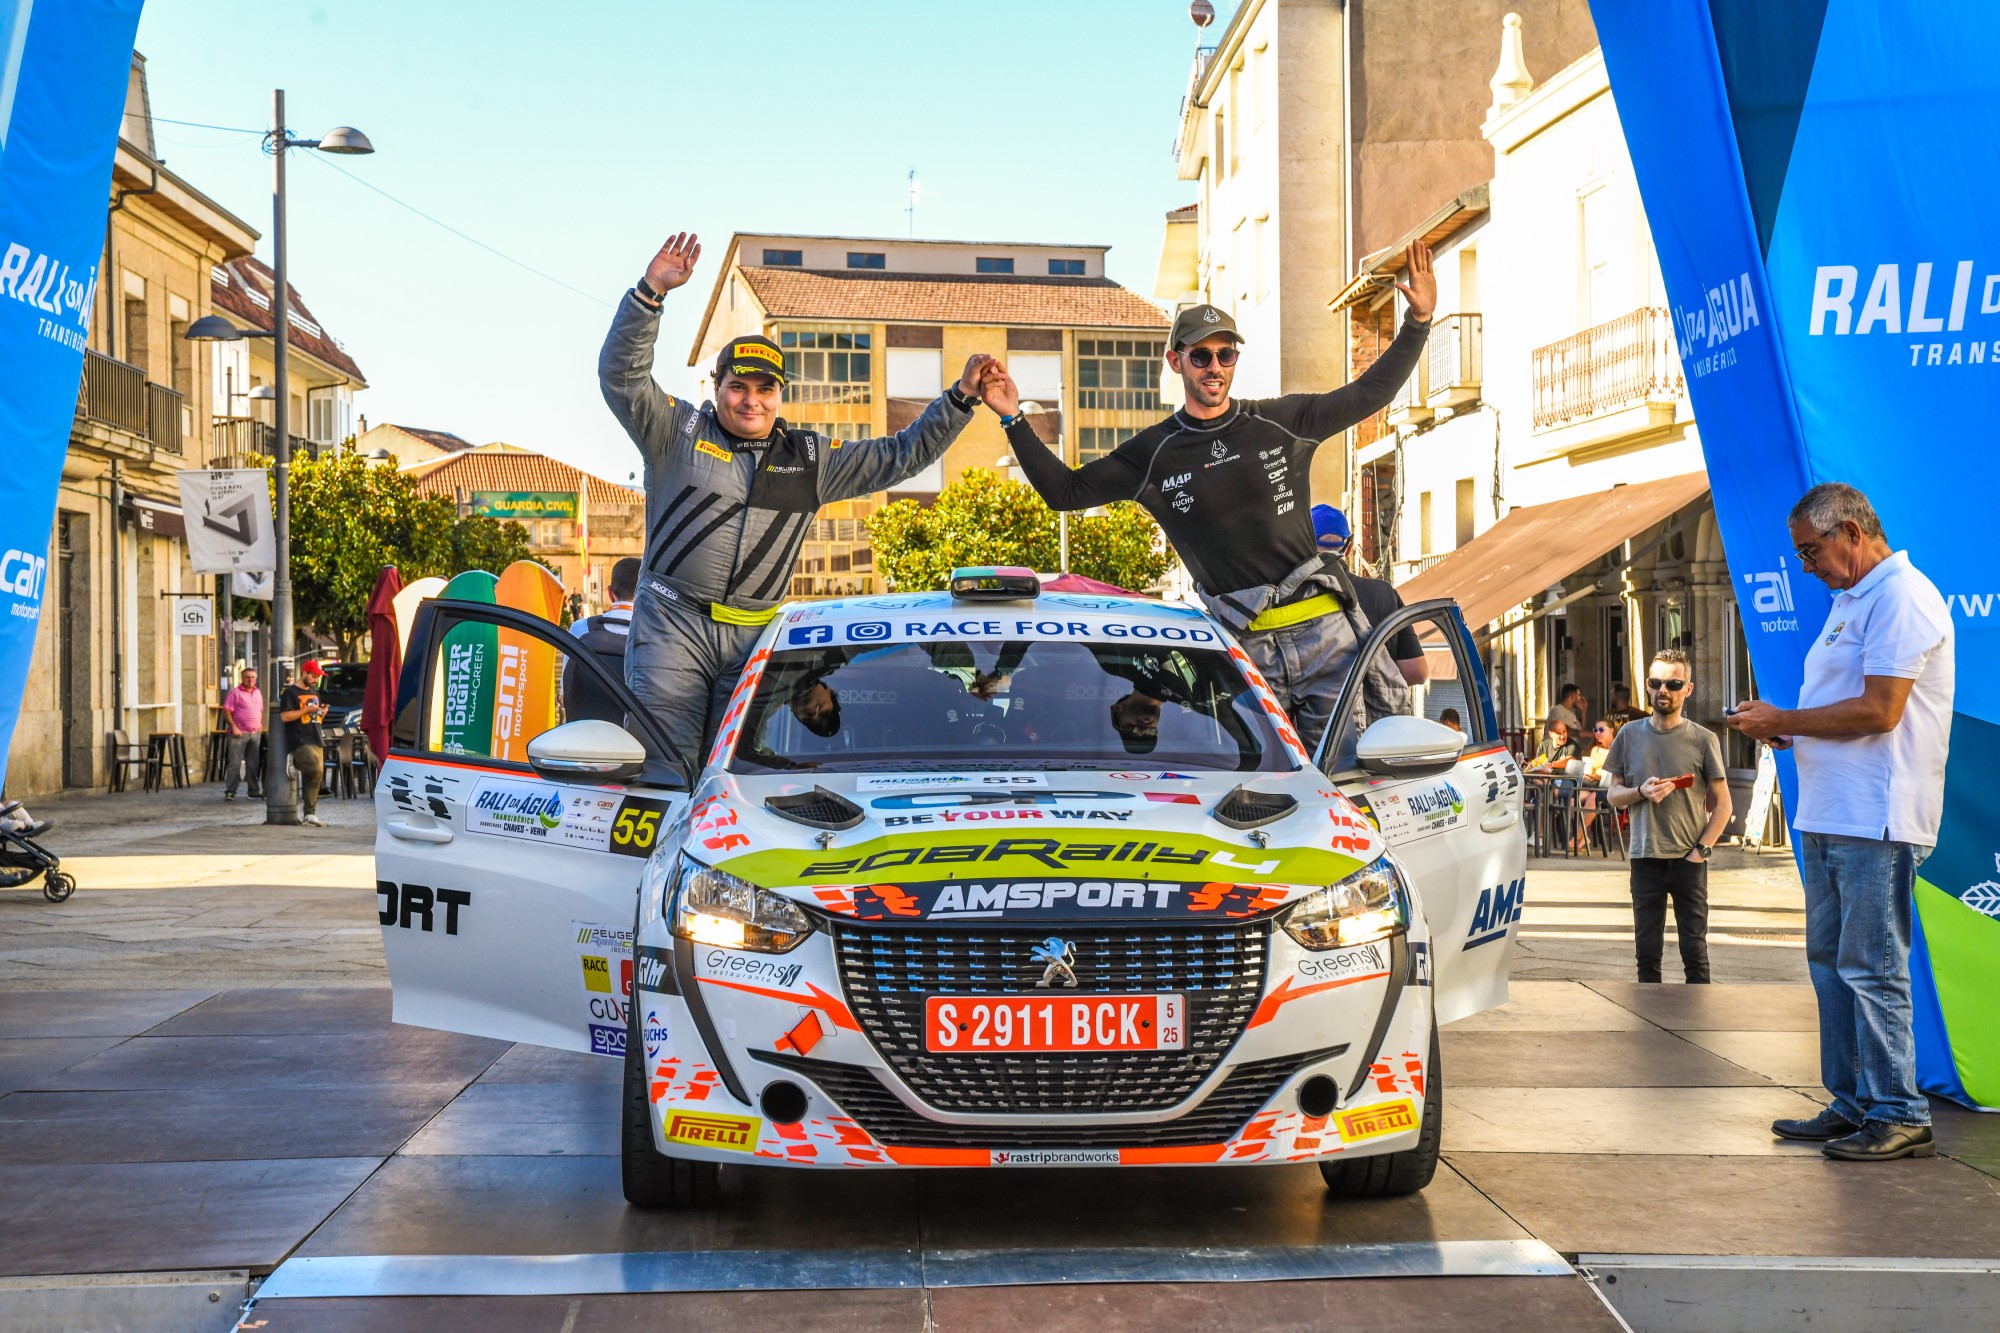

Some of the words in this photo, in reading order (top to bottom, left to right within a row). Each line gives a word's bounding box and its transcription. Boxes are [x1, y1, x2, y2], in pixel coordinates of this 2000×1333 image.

[0, 242, 69, 316] RALI
[1809, 260, 1974, 335] RALI
[1702, 272, 1760, 348] ÁGUA
[739, 346, 781, 364] PIRELLI
[699, 442, 728, 460] PIRELLI
[1161, 472, 1192, 492] MAP
[494, 501, 543, 511] GUARDIA
[546, 501, 574, 511] CIVIL
[1171, 495, 1195, 509] FUCHS
[905, 621, 1003, 636] RACE
[1015, 621, 1091, 636] FOR
[1102, 623, 1214, 642] GOOD
[445, 644, 462, 726] POSTER
[454, 644, 473, 726] DIGITAL
[514, 648, 528, 737] motorsport
[838, 689, 897, 704] sparco
[983, 776, 1037, 784] 55
[475, 790, 512, 811] RALI
[508, 798, 521, 808] DA
[518, 793, 560, 818] ÁGUA
[1407, 794, 1432, 816] RALI
[1433, 787, 1460, 809] ÁGUA
[613, 807, 661, 848] 55
[885, 813, 935, 827] BE
[937, 809, 1044, 822] YOUR
[1050, 809, 1132, 821] WAY
[503, 823, 525, 834] CHAVES
[930, 882, 1181, 913] AMSPORT
[583, 958, 607, 973] RACC
[706, 949, 786, 979] Greens
[1298, 950, 1372, 976] Greens
[1313, 965, 1371, 981] restaurante
[708, 969, 772, 983] restaurante
[1166, 1002, 1175, 1019] 5
[643, 1027, 668, 1042] FUCHS
[938, 1003, 958, 1047] S
[971, 1004, 1053, 1046] 2911
[1071, 1002, 1141, 1046] BCK
[1163, 1027, 1178, 1043] 25
[668, 1115, 751, 1146] PIRELLI
[1341, 1104, 1412, 1137] PIRELLI
[1010, 1150, 1119, 1165] rastripbrandworks
